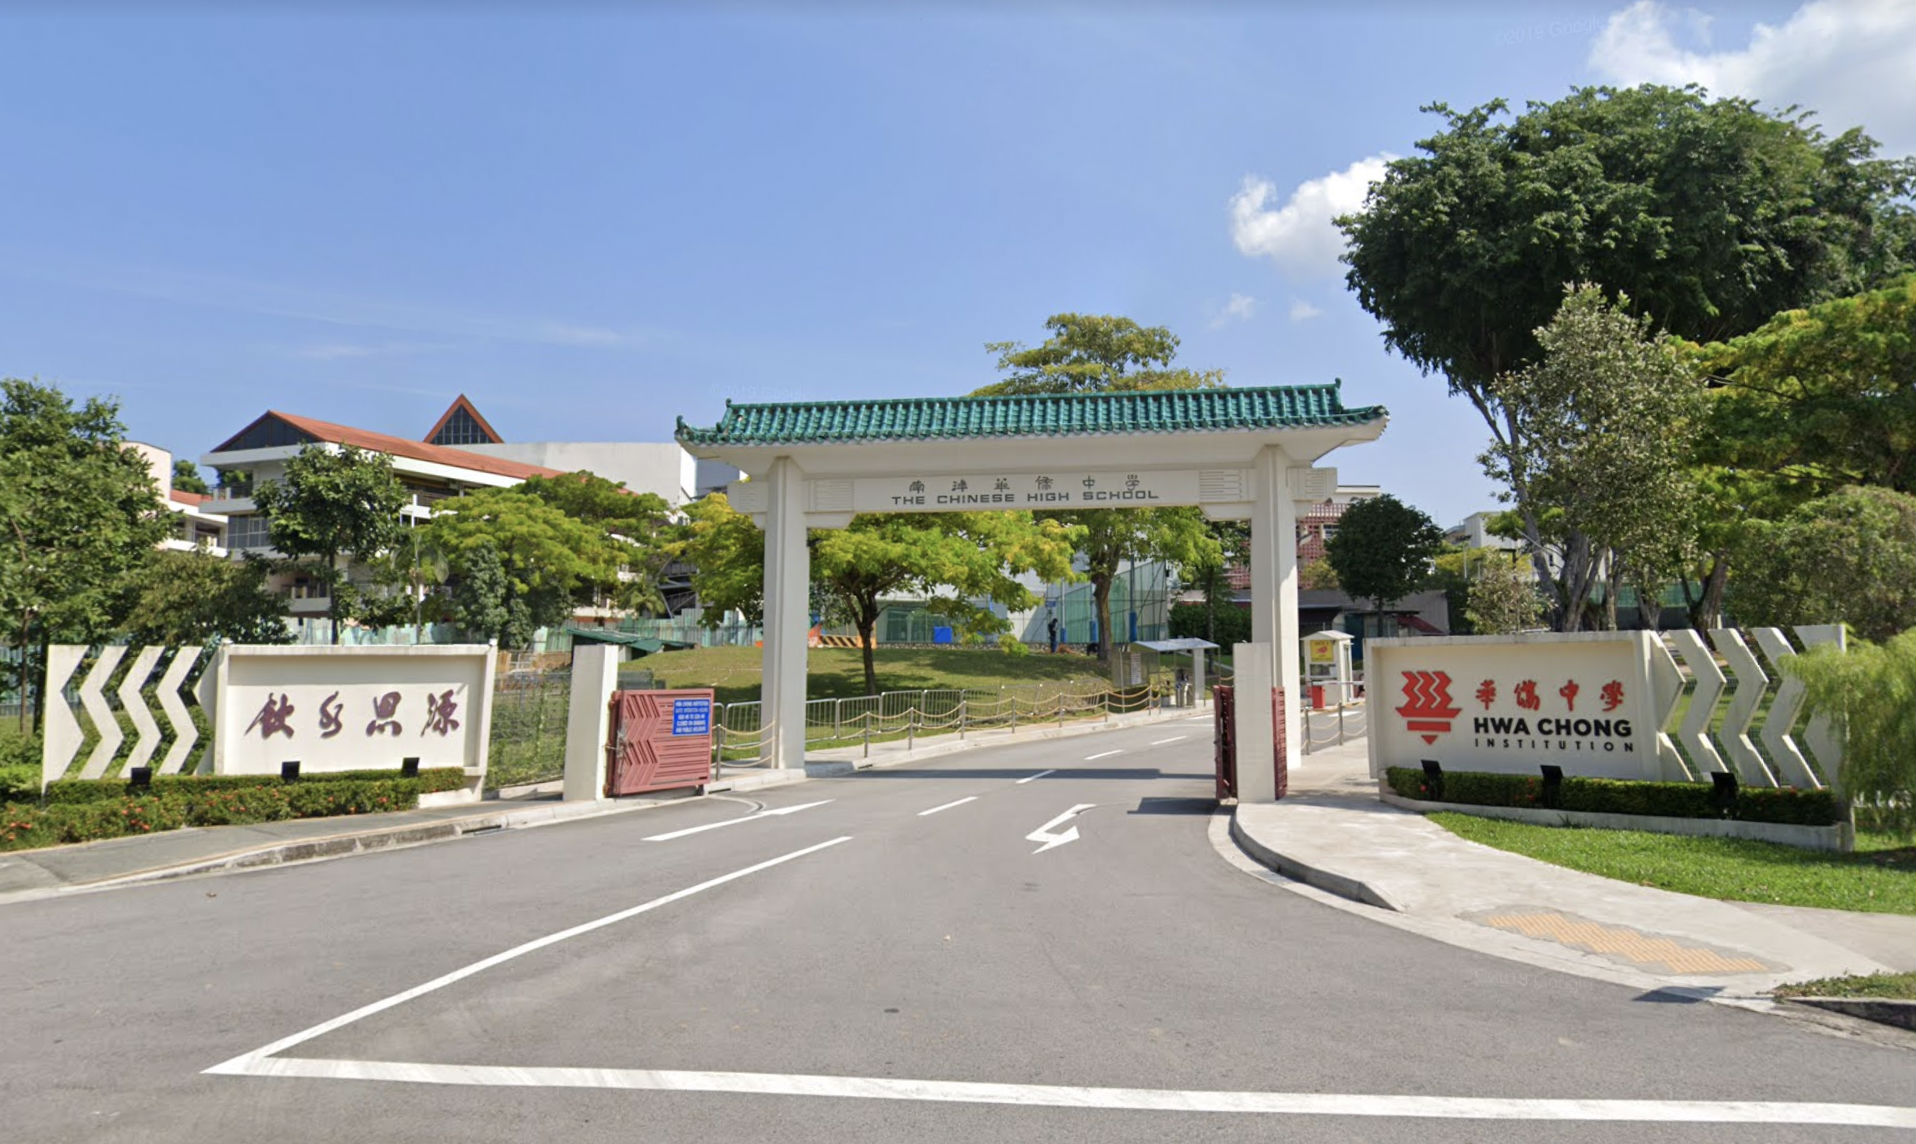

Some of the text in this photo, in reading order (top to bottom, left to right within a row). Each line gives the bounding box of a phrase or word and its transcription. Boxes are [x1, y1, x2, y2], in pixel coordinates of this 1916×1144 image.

[892, 490, 1159, 505] THE CHINESE HIGH SCHOOL
[1474, 717, 1632, 737] HWA CHONG
[1475, 738, 1634, 752] INSTITUTION
